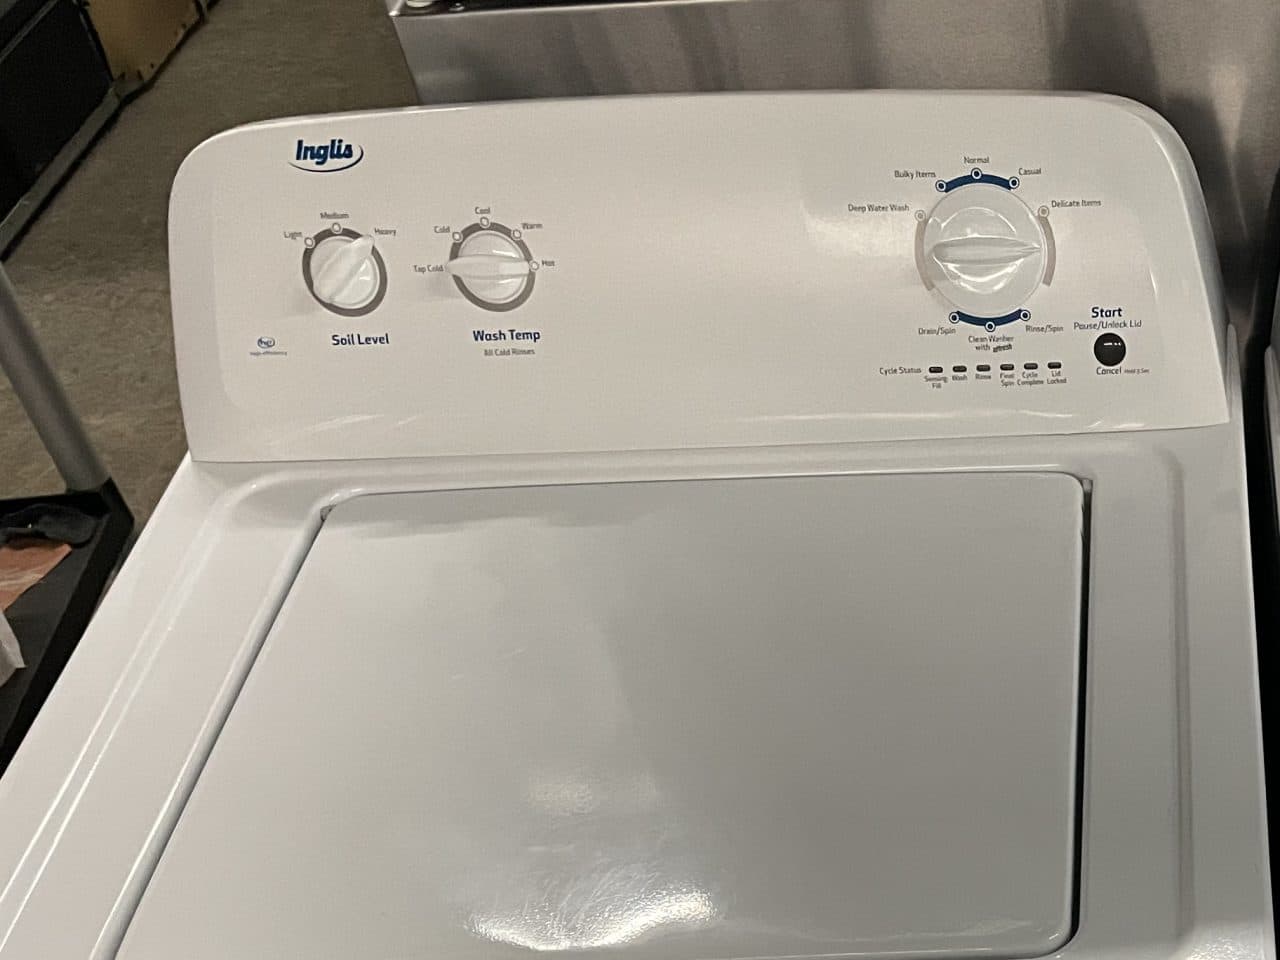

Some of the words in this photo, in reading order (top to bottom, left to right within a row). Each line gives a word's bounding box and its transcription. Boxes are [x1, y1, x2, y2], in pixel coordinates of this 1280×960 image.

[295, 139, 353, 165] Inglis
[963, 156, 990, 164] Normal
[894, 170, 914, 180] Bulky
[1018, 168, 1042, 176] Casual
[1051, 200, 1079, 208] Delicate
[1080, 199, 1102, 207] Items
[474, 206, 491, 215] Cool
[848, 204, 864, 214] Deep
[866, 204, 888, 212] Water
[890, 204, 910, 212] Wash
[320, 212, 349, 220] Medium
[433, 225, 450, 234] Cold
[521, 222, 543, 230] Warm
[284, 231, 302, 239] Light
[374, 227, 396, 237] Heavy
[541, 259, 555, 267] Hot
[413, 264, 427, 274] Tap
[428, 264, 444, 272] Cold
[1091, 307, 1122, 318] Start
[1025, 325, 1064, 333] Rinse/Spin
[1073, 320, 1127, 330] Pause/Unlock
[1130, 320, 1142, 328] Lid
[472, 330, 506, 342] Wash
[508, 329, 541, 342] Temp
[918, 327, 956, 335] Drain/Spin
[332, 333, 355, 346] Soil
[357, 332, 389, 345] Level
[968, 335, 988, 343] Clean
[493, 349, 509, 357] Cold
[511, 348, 535, 356] Rinses
[879, 367, 897, 376] Cycle
[899, 366, 922, 374] Status
[1022, 371, 1038, 379] Cycle
[1096, 366, 1122, 375] Cancel
